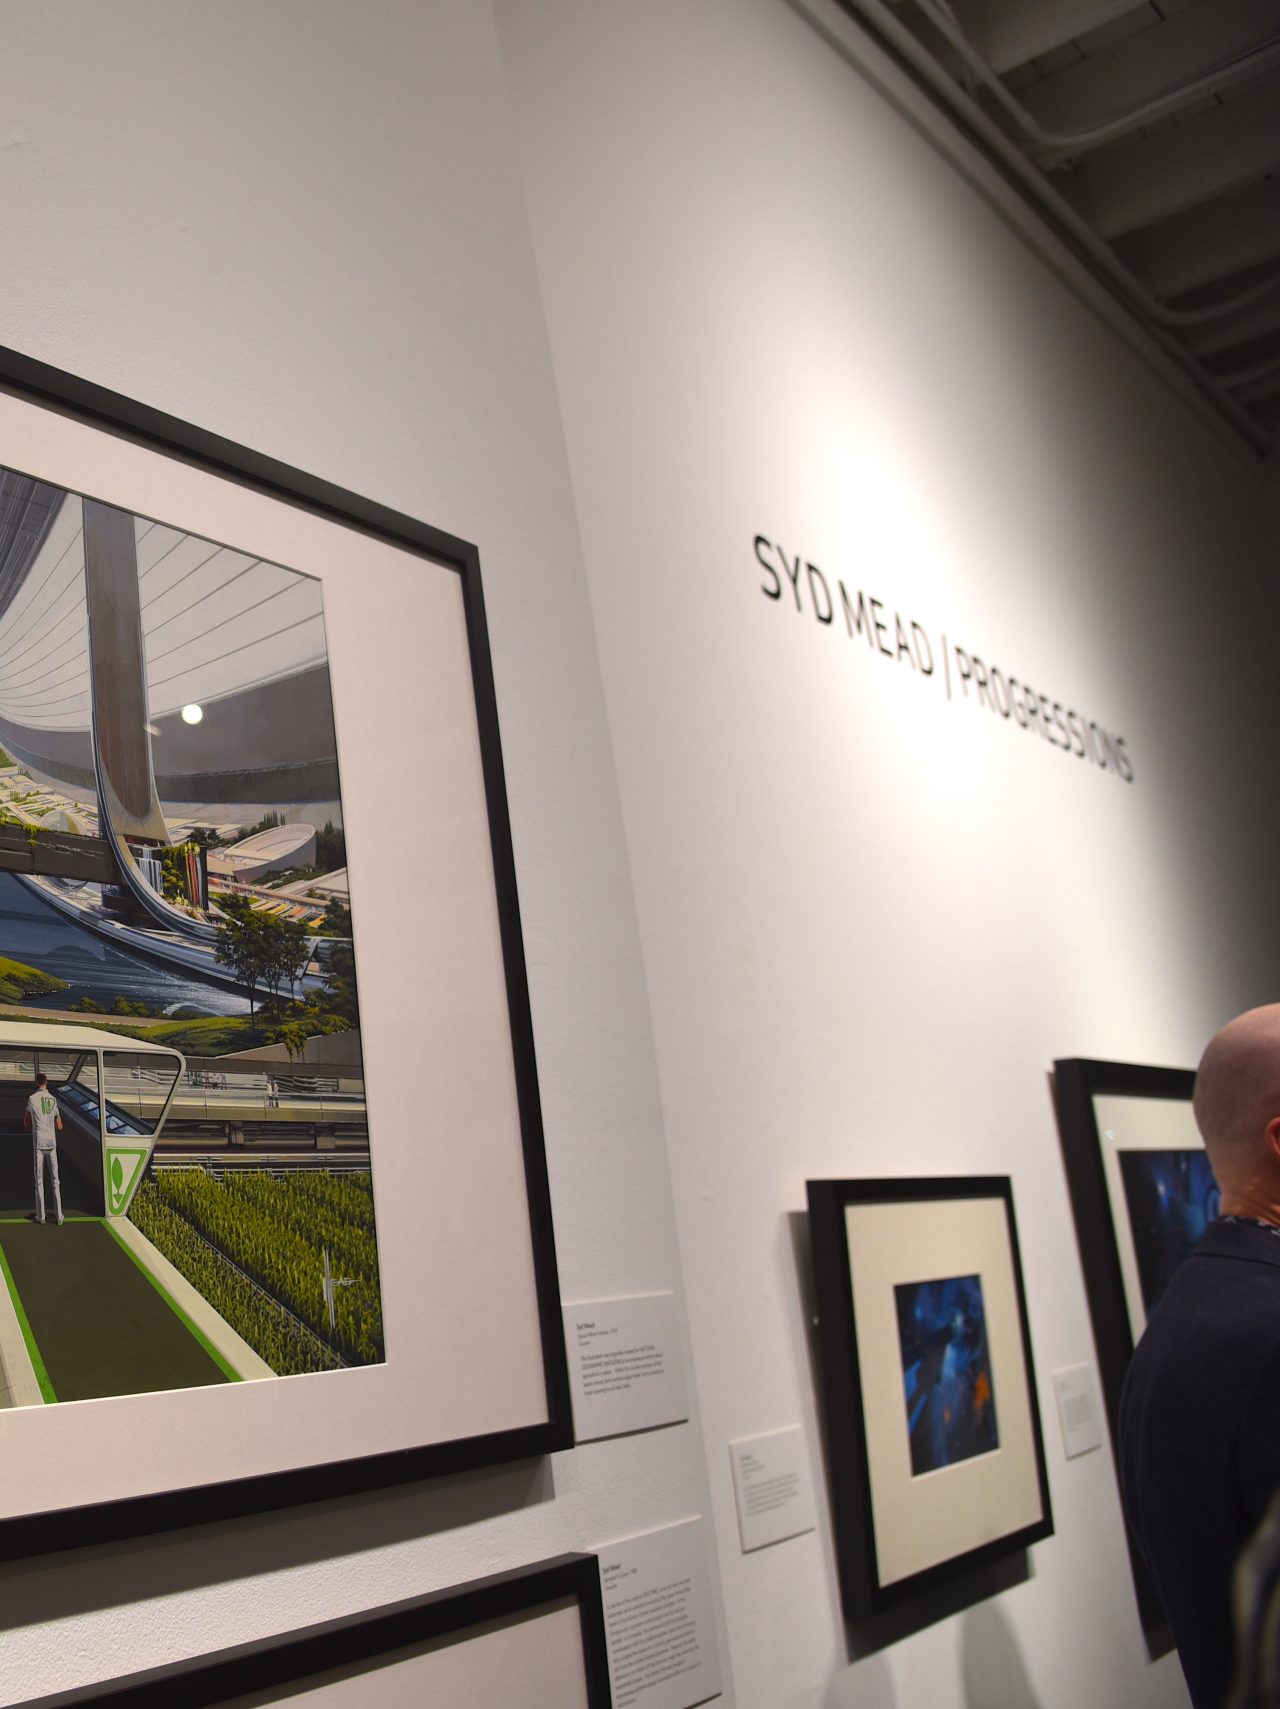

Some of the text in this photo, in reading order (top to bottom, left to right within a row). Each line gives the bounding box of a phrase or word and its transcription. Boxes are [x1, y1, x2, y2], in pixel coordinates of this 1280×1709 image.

[753, 533, 834, 626] SYD
[838, 578, 934, 677] MEAD
[954, 645, 1134, 785] PROGRESSIONS
